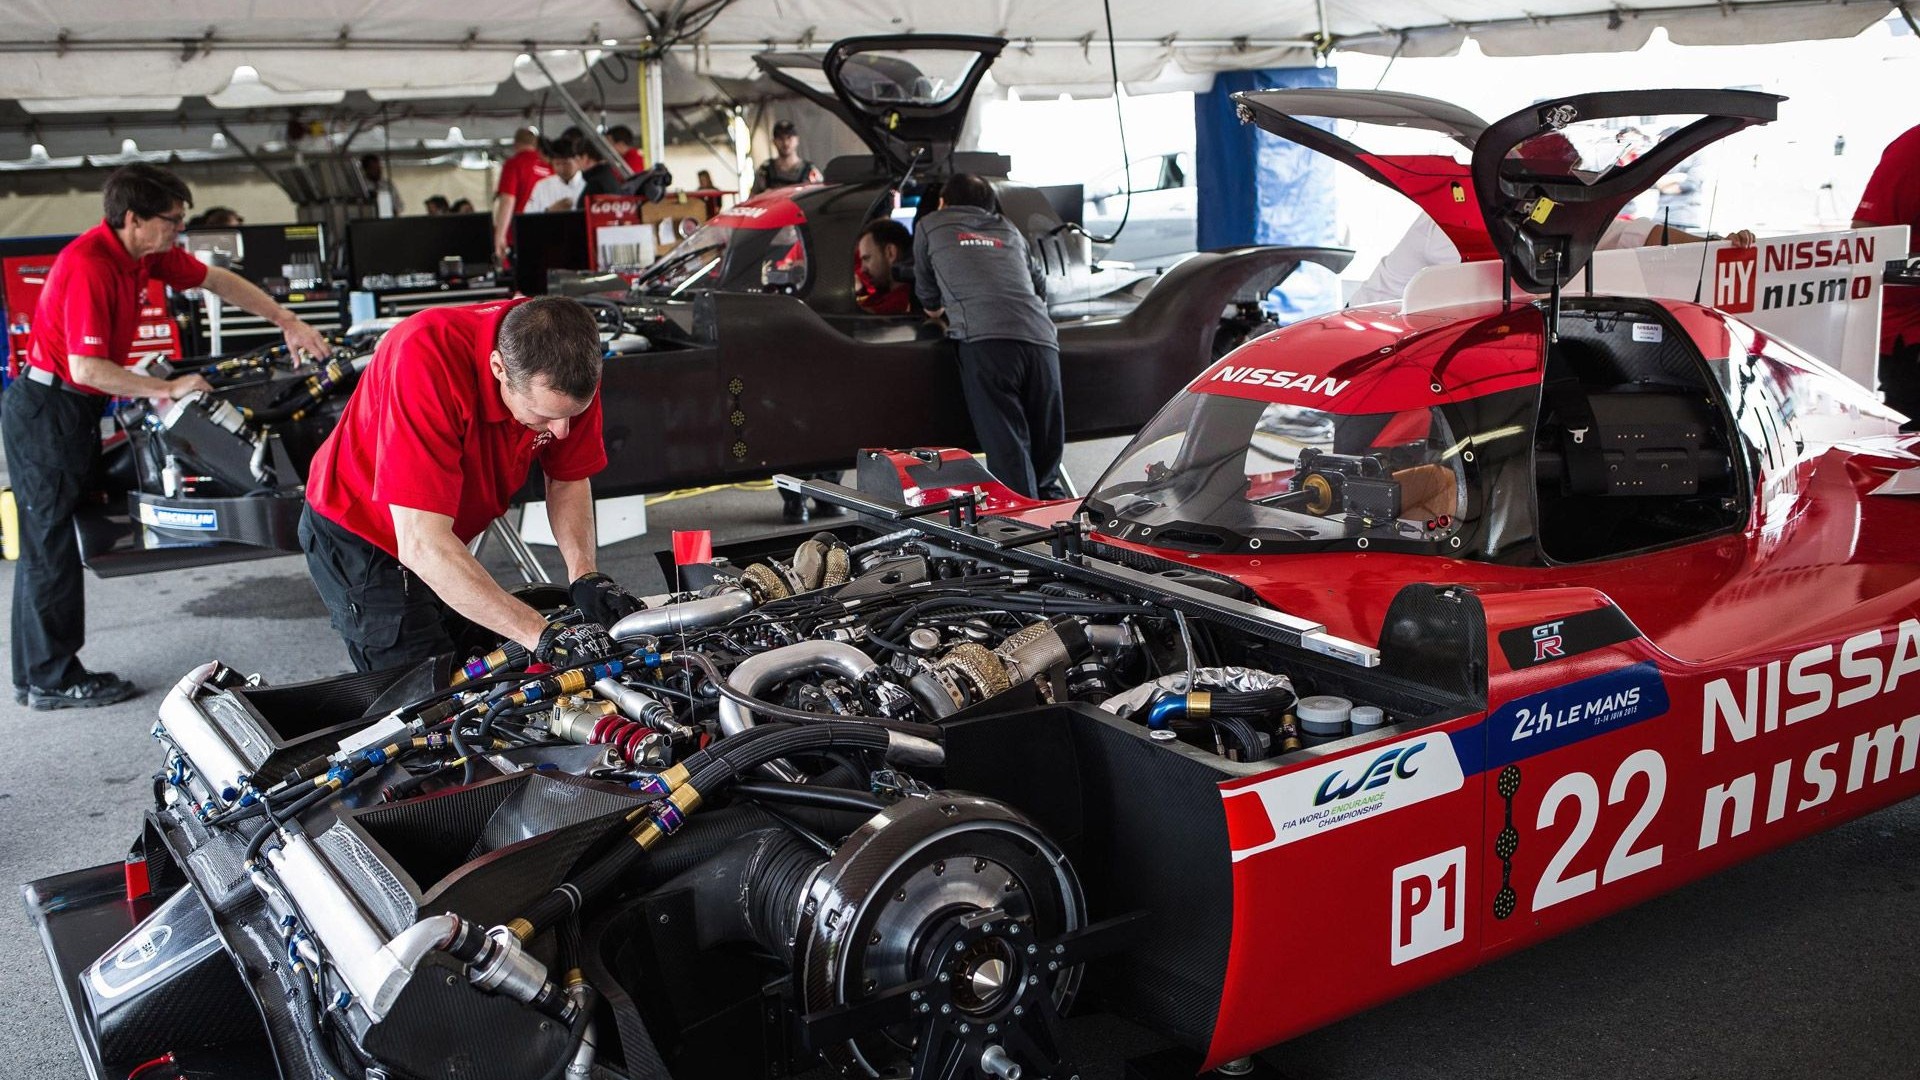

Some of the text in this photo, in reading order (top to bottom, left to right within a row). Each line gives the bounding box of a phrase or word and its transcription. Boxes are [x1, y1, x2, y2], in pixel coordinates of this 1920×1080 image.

[1764, 236, 1875, 273] NISSAN
[1717, 260, 1754, 306] HY
[1762, 276, 1872, 311] nismo
[1210, 366, 1351, 397] NISSAN
[1532, 621, 1564, 639] GT
[1534, 635, 1566, 662] R
[1556, 705, 1582, 728] LE
[1584, 687, 1640, 719] MANS
[1312, 742, 1427, 806] WEC
[1282, 792, 1387, 830] FIA WORLD ENDURANCE
[1318, 802, 1383, 828] CHAMPIONSHIP
[1532, 749, 1667, 912] 22
[1400, 863, 1457, 947] P1
